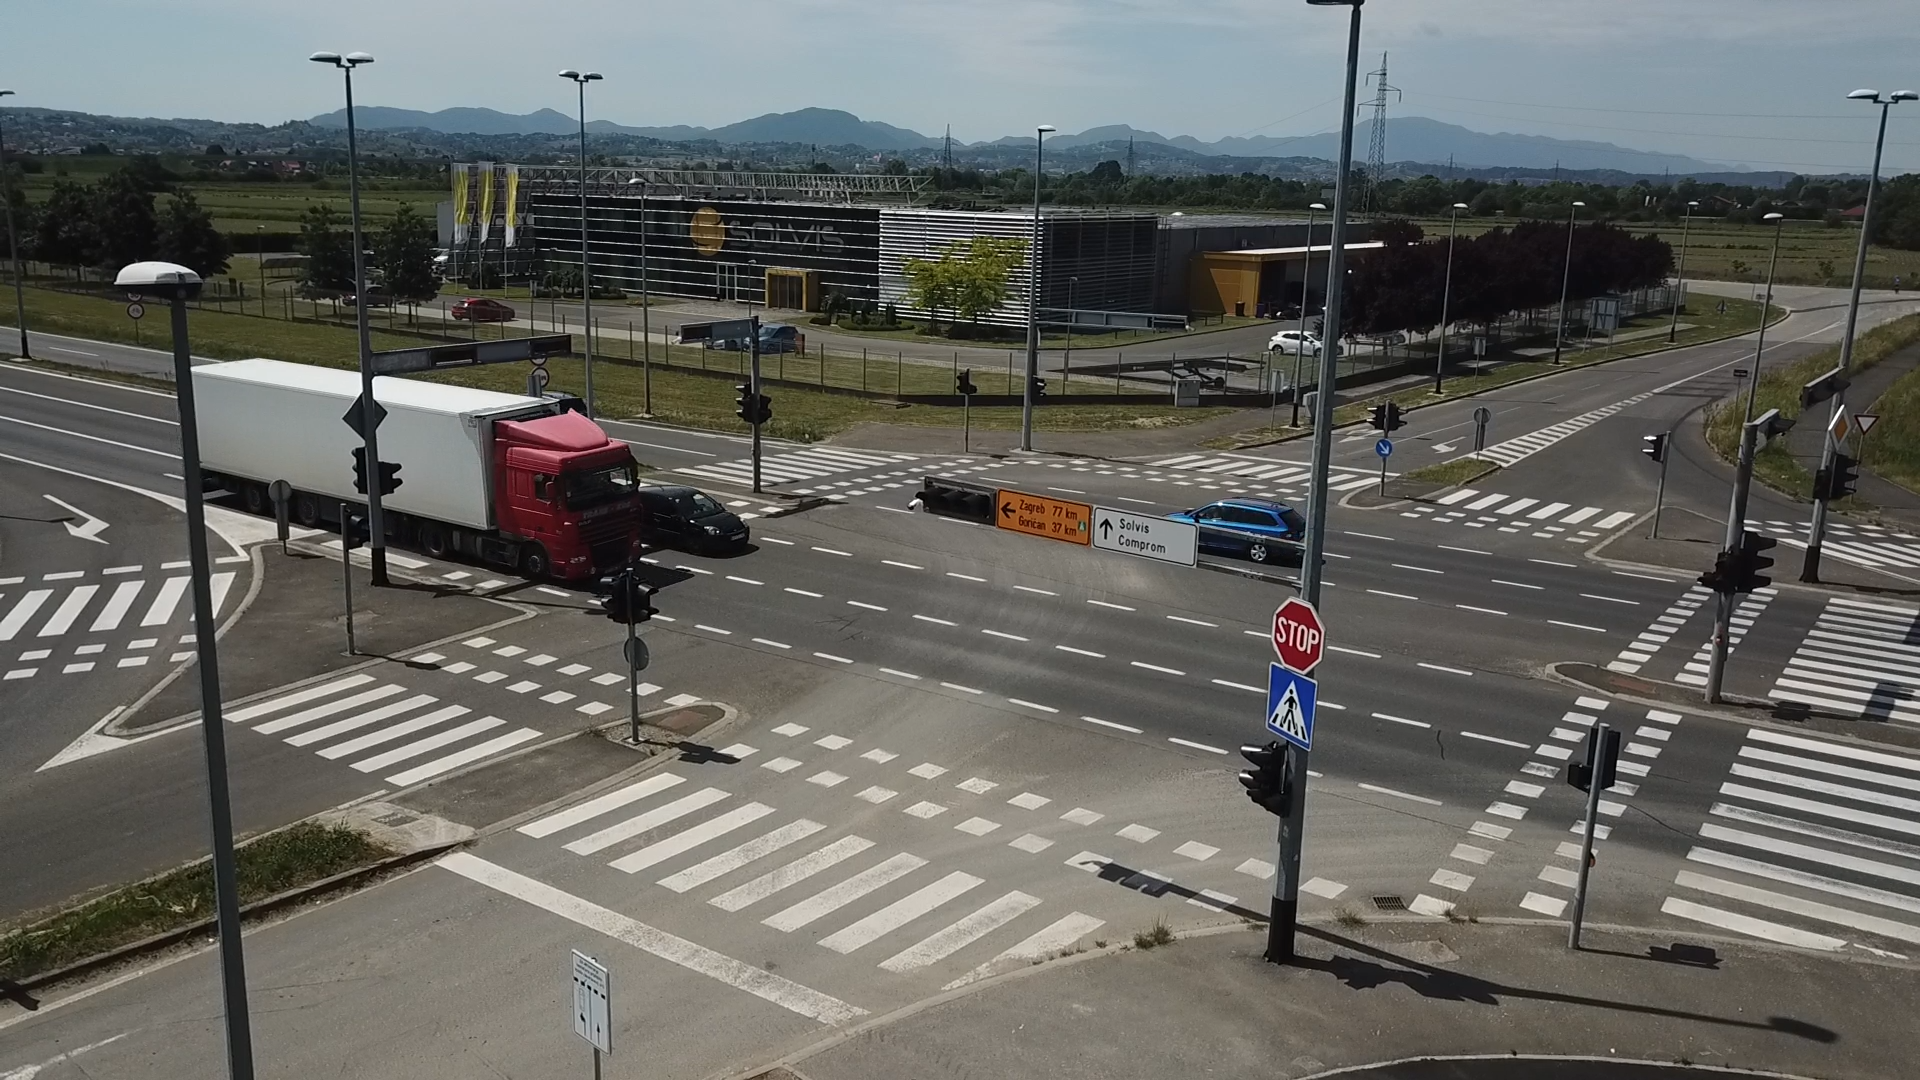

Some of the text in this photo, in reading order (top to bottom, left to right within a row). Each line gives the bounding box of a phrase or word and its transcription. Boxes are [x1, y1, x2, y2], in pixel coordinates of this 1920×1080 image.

[729, 221, 845, 253] SOLVIS
[1019, 499, 1078, 520] Zagreb 77 km
[1051, 522, 1062, 533] 37
[1064, 524, 1077, 536] km
[1119, 518, 1150, 534] Solvis
[1118, 535, 1166, 554] Comprom
[1276, 616, 1320, 654] STOP
